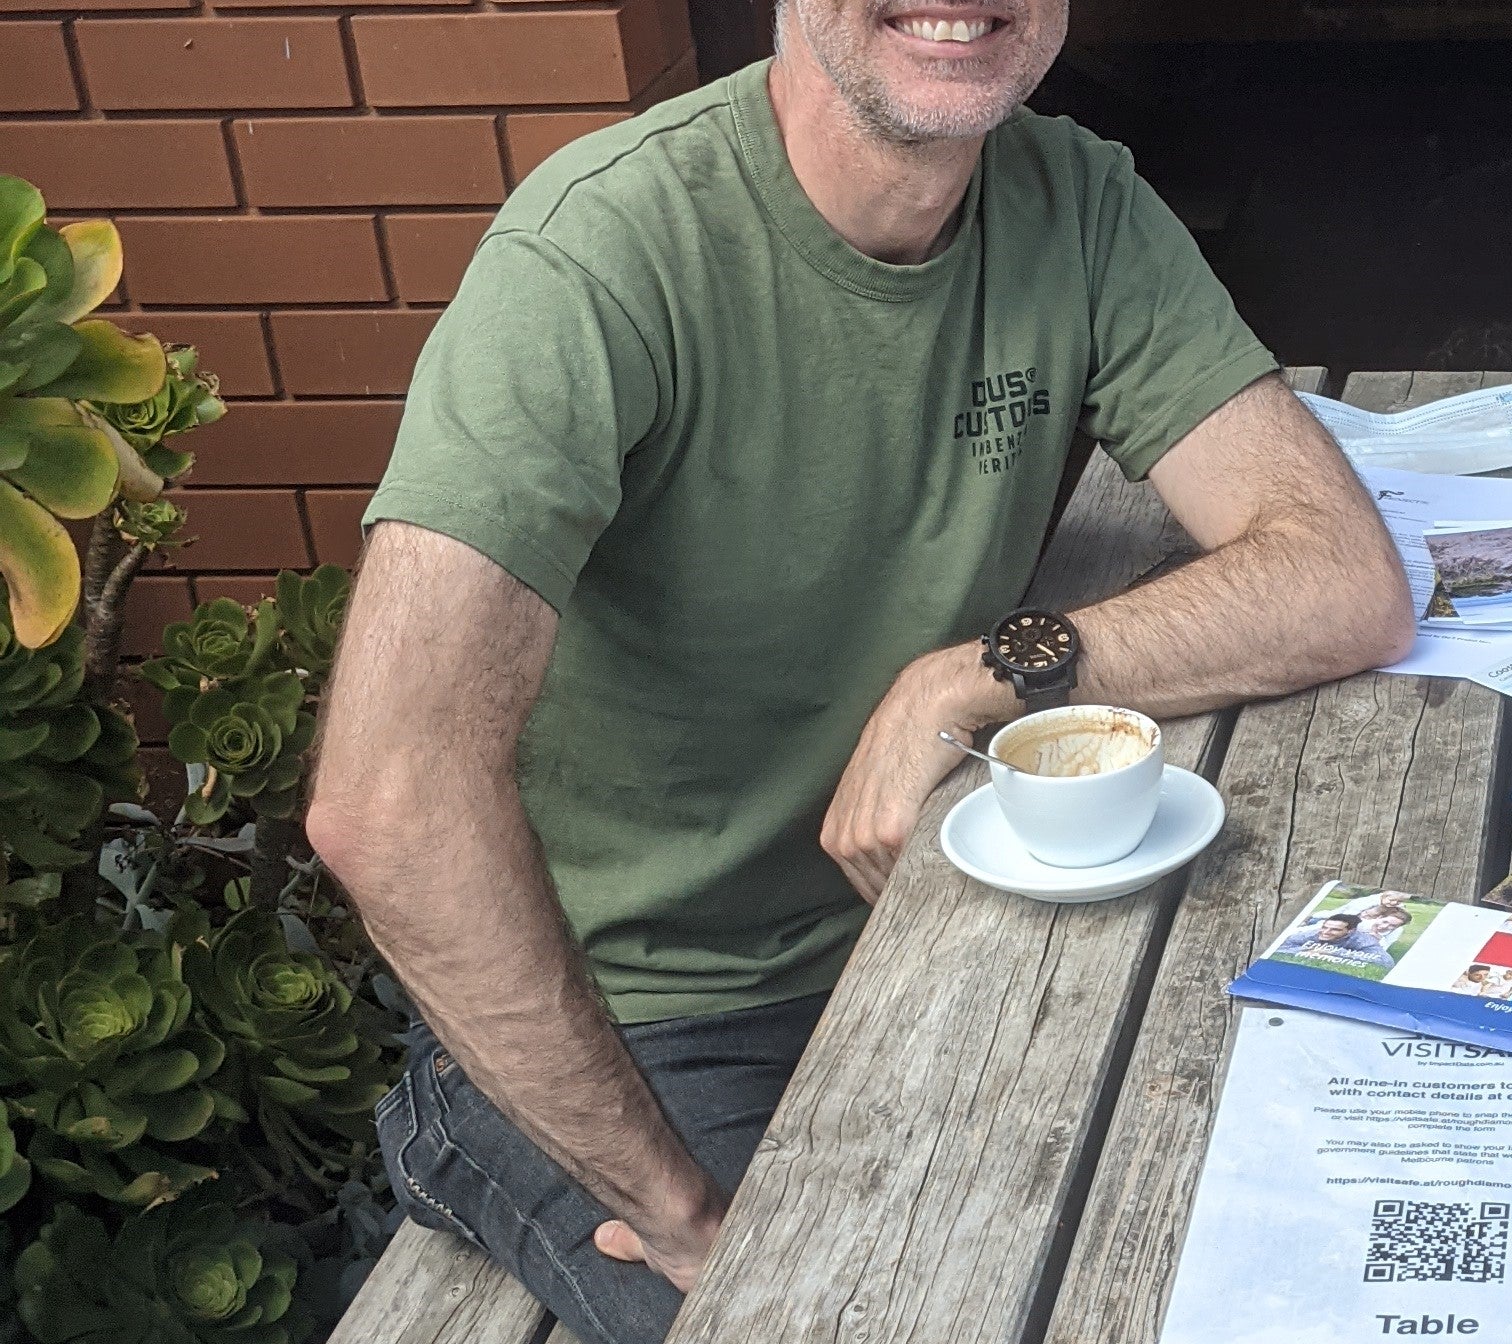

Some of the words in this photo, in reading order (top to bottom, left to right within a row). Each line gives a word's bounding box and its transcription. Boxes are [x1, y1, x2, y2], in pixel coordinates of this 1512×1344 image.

[1301, 940, 1344, 953] Enjoy
[1340, 948, 1382, 960] your
[1294, 951, 1368, 968] memories
[1327, 1077, 1349, 1086] All
[1354, 1077, 1408, 1088] dine-in
[1412, 1080, 1496, 1090] customers
[1329, 1088, 1363, 1096] with
[1367, 1090, 1426, 1099] contact
[1430, 1091, 1483, 1100] details
[1488, 1092, 1503, 1100] at
[1376, 1314, 1480, 1335] Table
